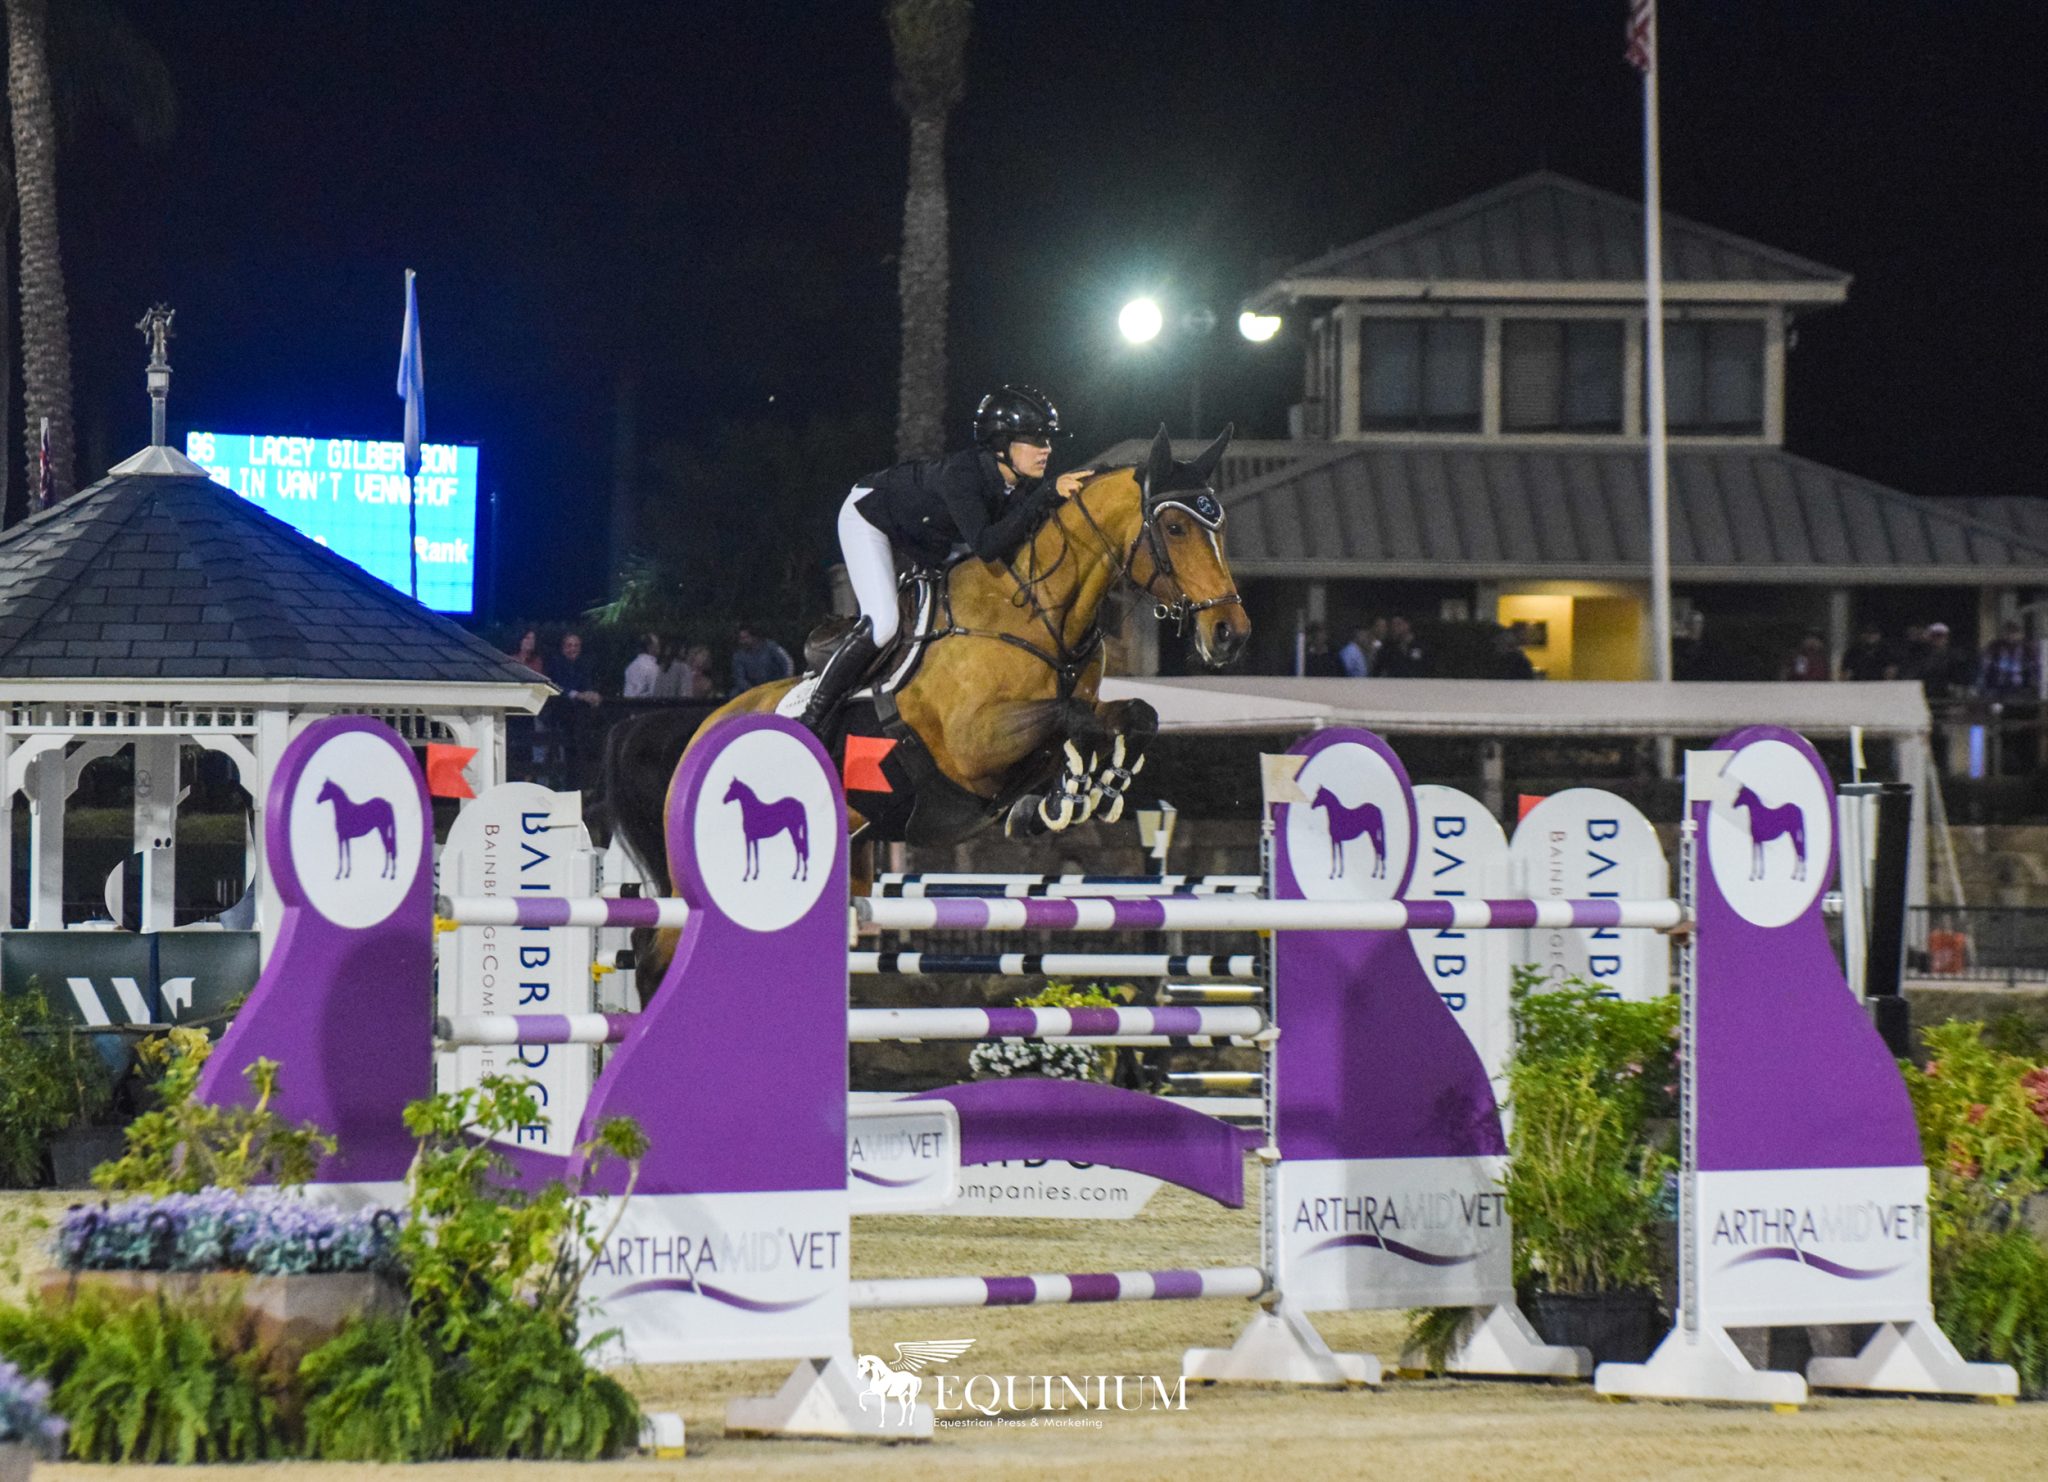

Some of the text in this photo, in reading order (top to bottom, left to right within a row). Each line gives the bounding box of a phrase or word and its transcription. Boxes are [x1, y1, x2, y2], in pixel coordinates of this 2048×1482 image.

[249, 434, 315, 468] LACEY
[328, 439, 458, 474] GILBERSON
[277, 468, 342, 500] VAN'T
[414, 536, 469, 563] Rank
[517, 812, 551, 1145] BAIBRDGE
[908, 1132, 943, 1160] VET
